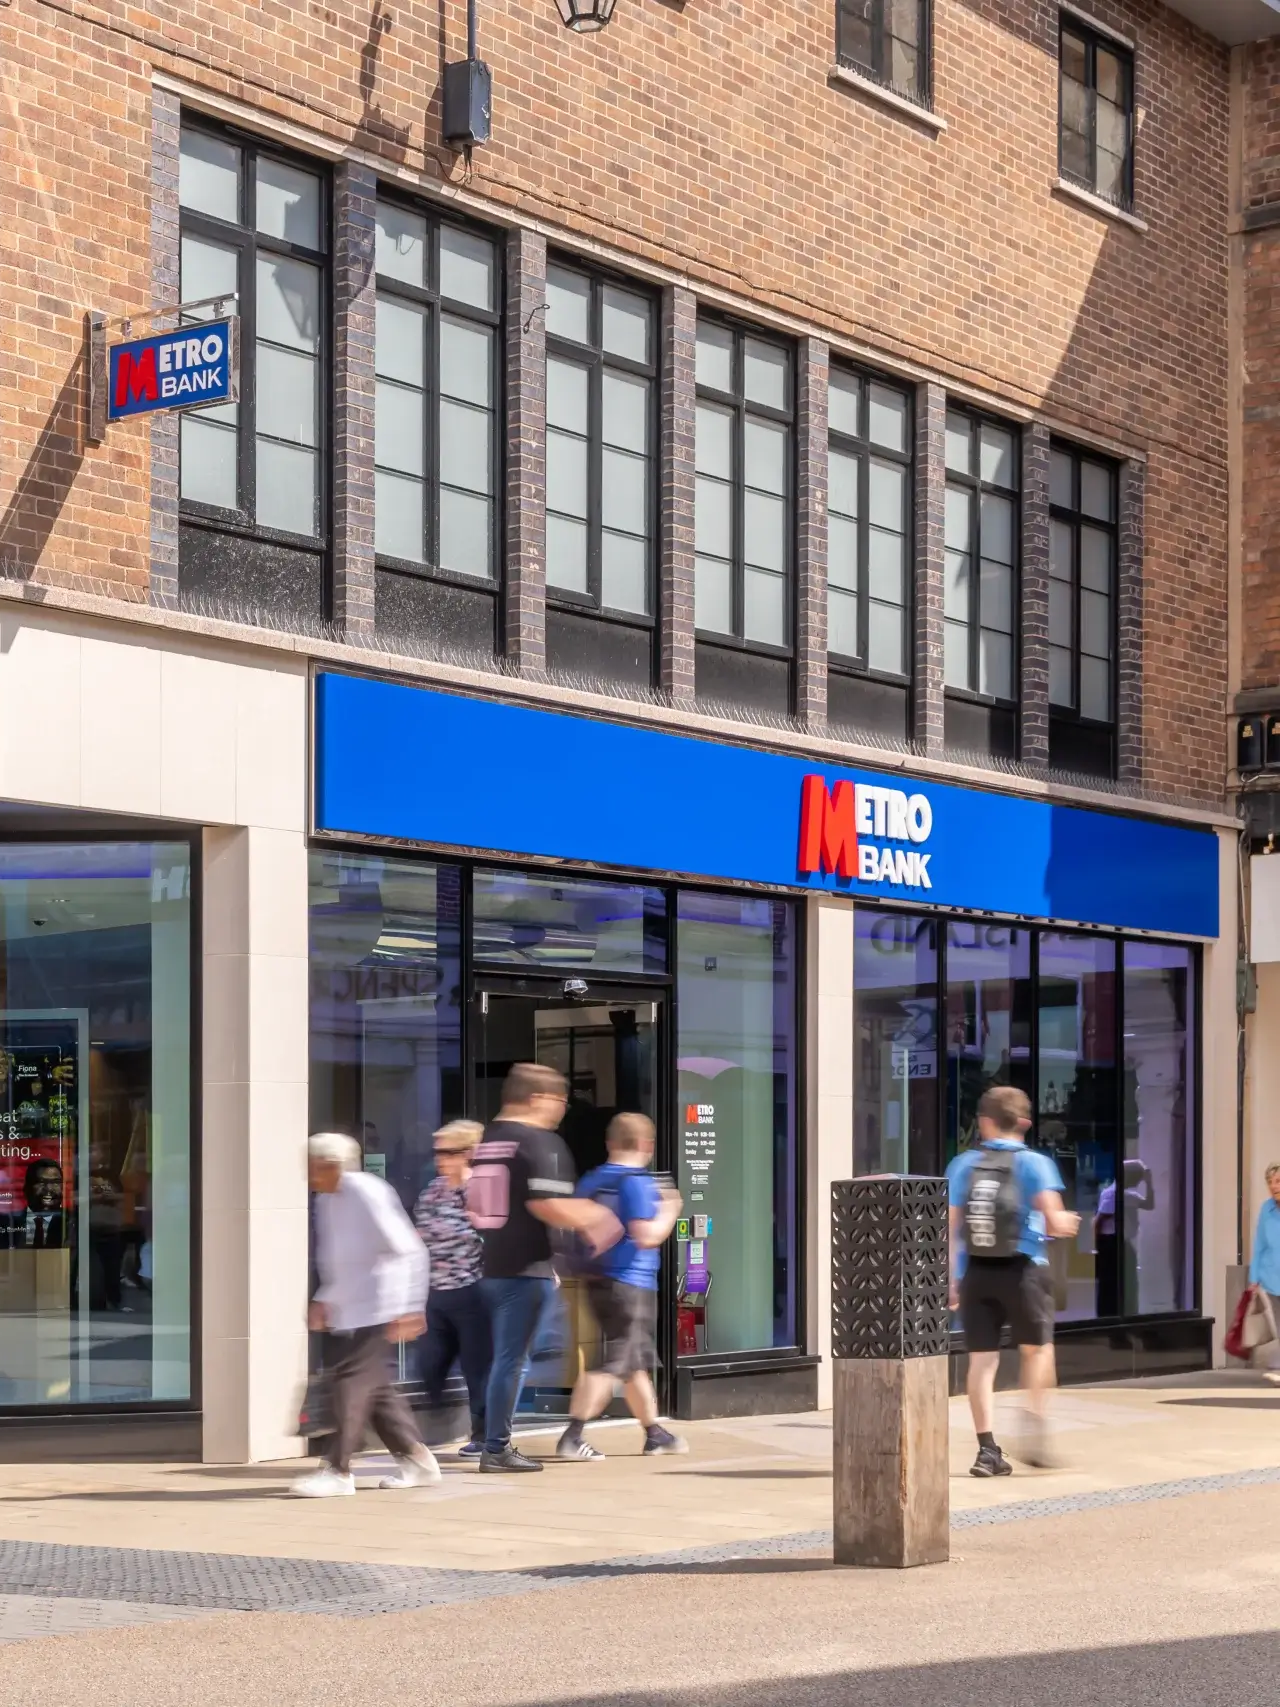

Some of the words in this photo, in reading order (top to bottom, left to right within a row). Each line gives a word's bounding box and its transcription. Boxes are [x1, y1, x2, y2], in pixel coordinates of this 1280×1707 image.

[115, 334, 223, 407] METRO
[162, 366, 223, 398] BANK
[798, 774, 933, 877] METRO
[858, 845, 933, 889] BANK
[686, 1104, 714, 1124] METRO
[698, 1116, 714, 1124] BANK
[8, 1126, 20, 1139] &
